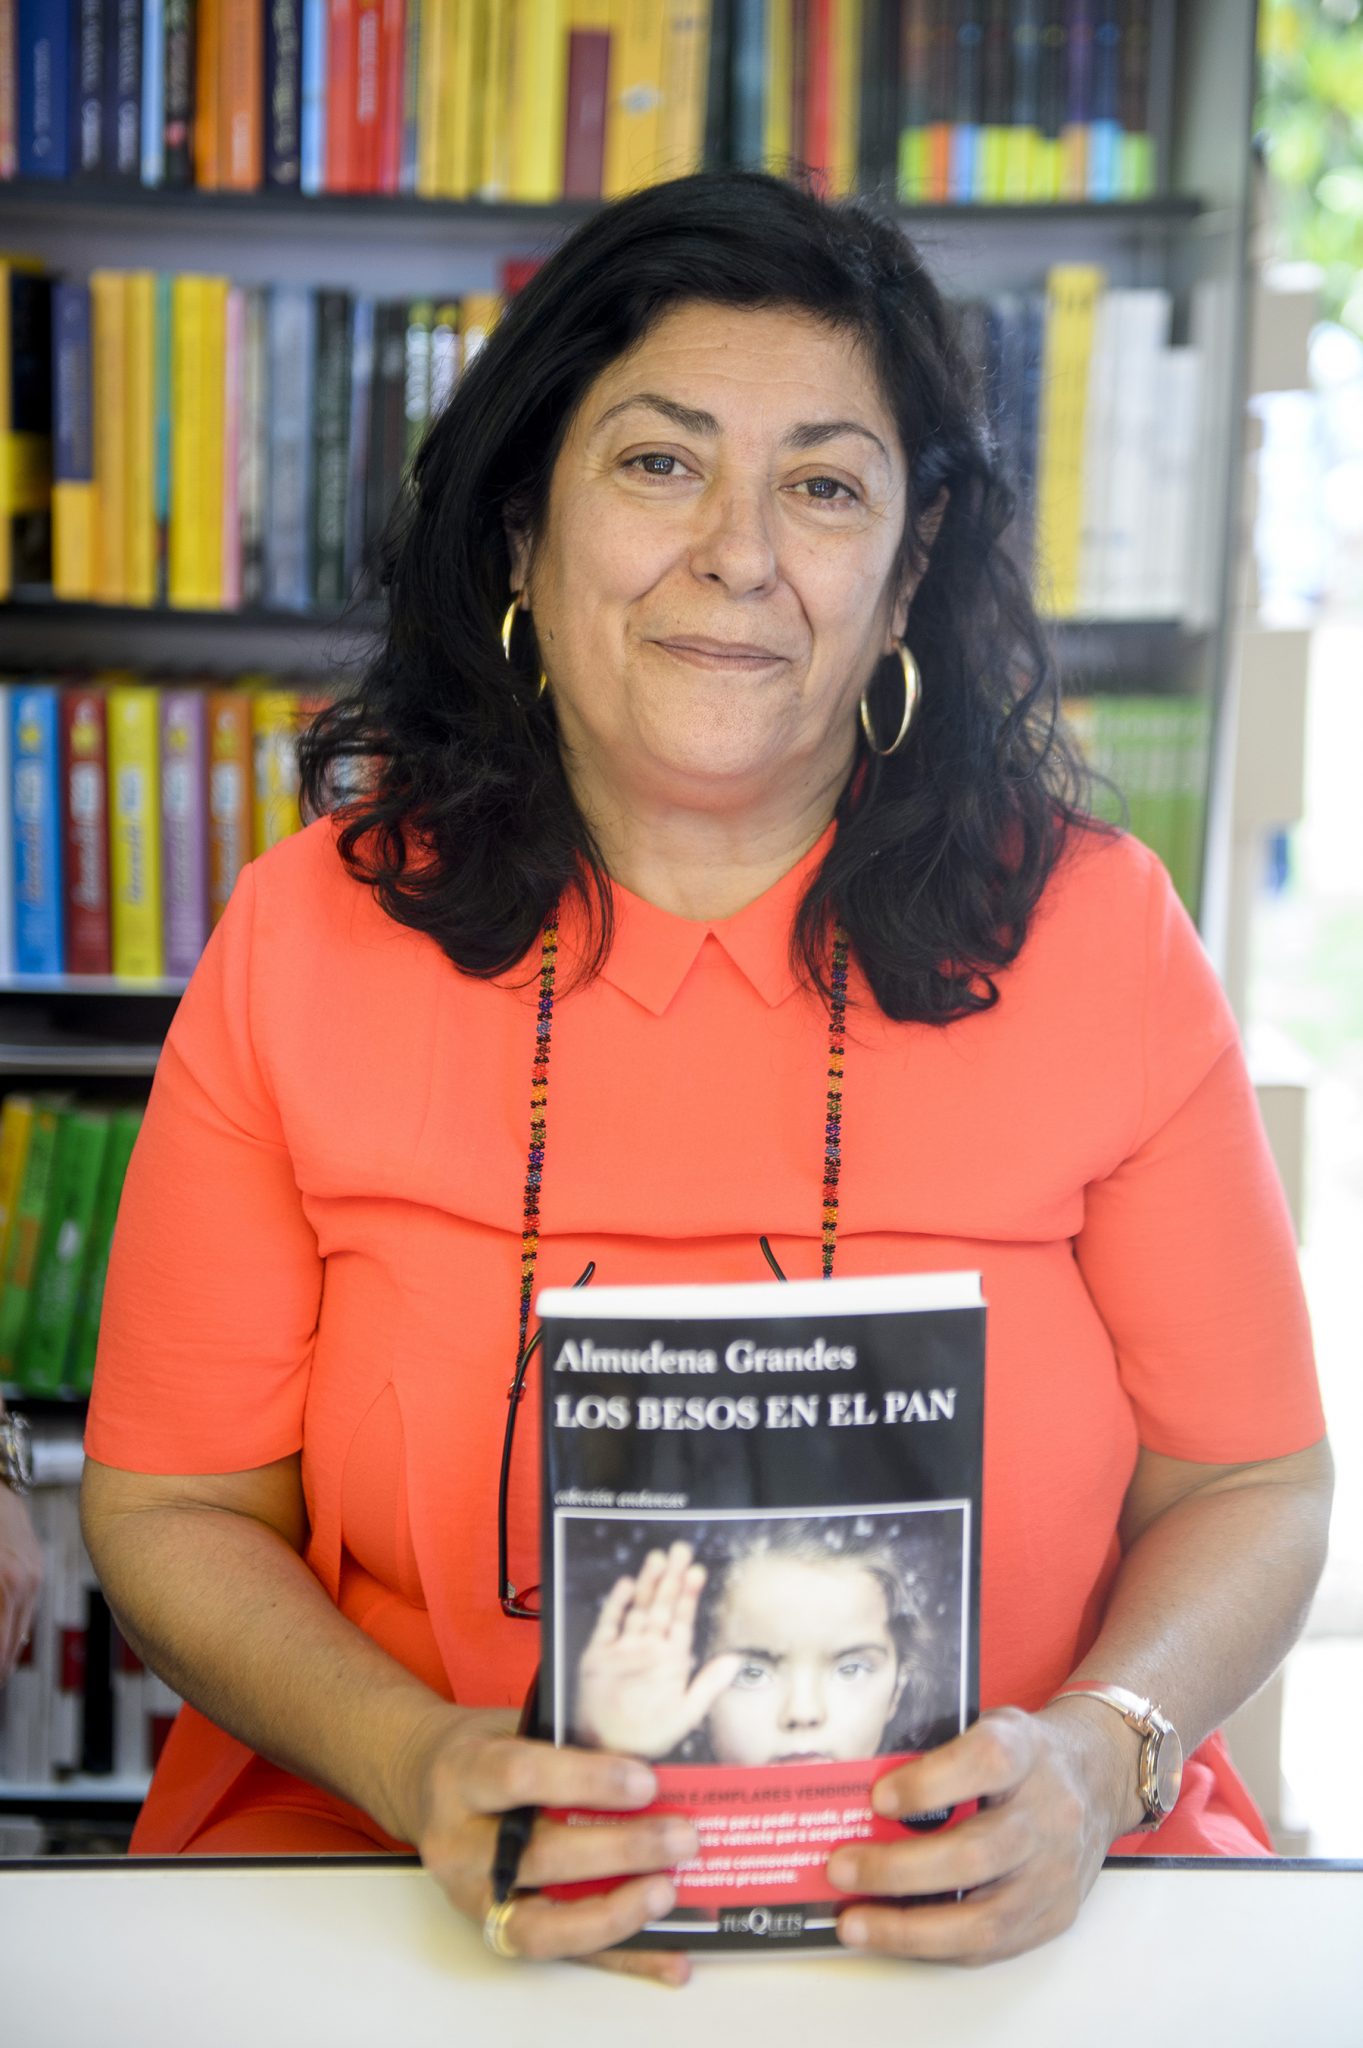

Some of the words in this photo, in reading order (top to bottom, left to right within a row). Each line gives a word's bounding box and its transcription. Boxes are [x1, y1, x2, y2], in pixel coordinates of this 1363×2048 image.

[554, 1337, 718, 1375] Almudena
[724, 1337, 857, 1374] Grandes
[554, 1395, 630, 1428] LOS
[636, 1397, 759, 1430] BESOS
[765, 1394, 819, 1428] EN
[828, 1392, 877, 1426] EL
[883, 1388, 956, 1424] PAN
[689, 1785, 791, 1805] EJEMPLARES
[796, 1781, 872, 1801] VENDIDOS
[729, 1815, 760, 1833] para
[761, 1812, 796, 1833] pedir
[842, 1808, 873, 1827] pero
[722, 1830, 775, 1847] valiente
[775, 1829, 807, 1847] para
[706, 1856, 731, 1871] una
[732, 1850, 821, 1871] conmovedora
[683, 1872, 734, 1887] nuestro
